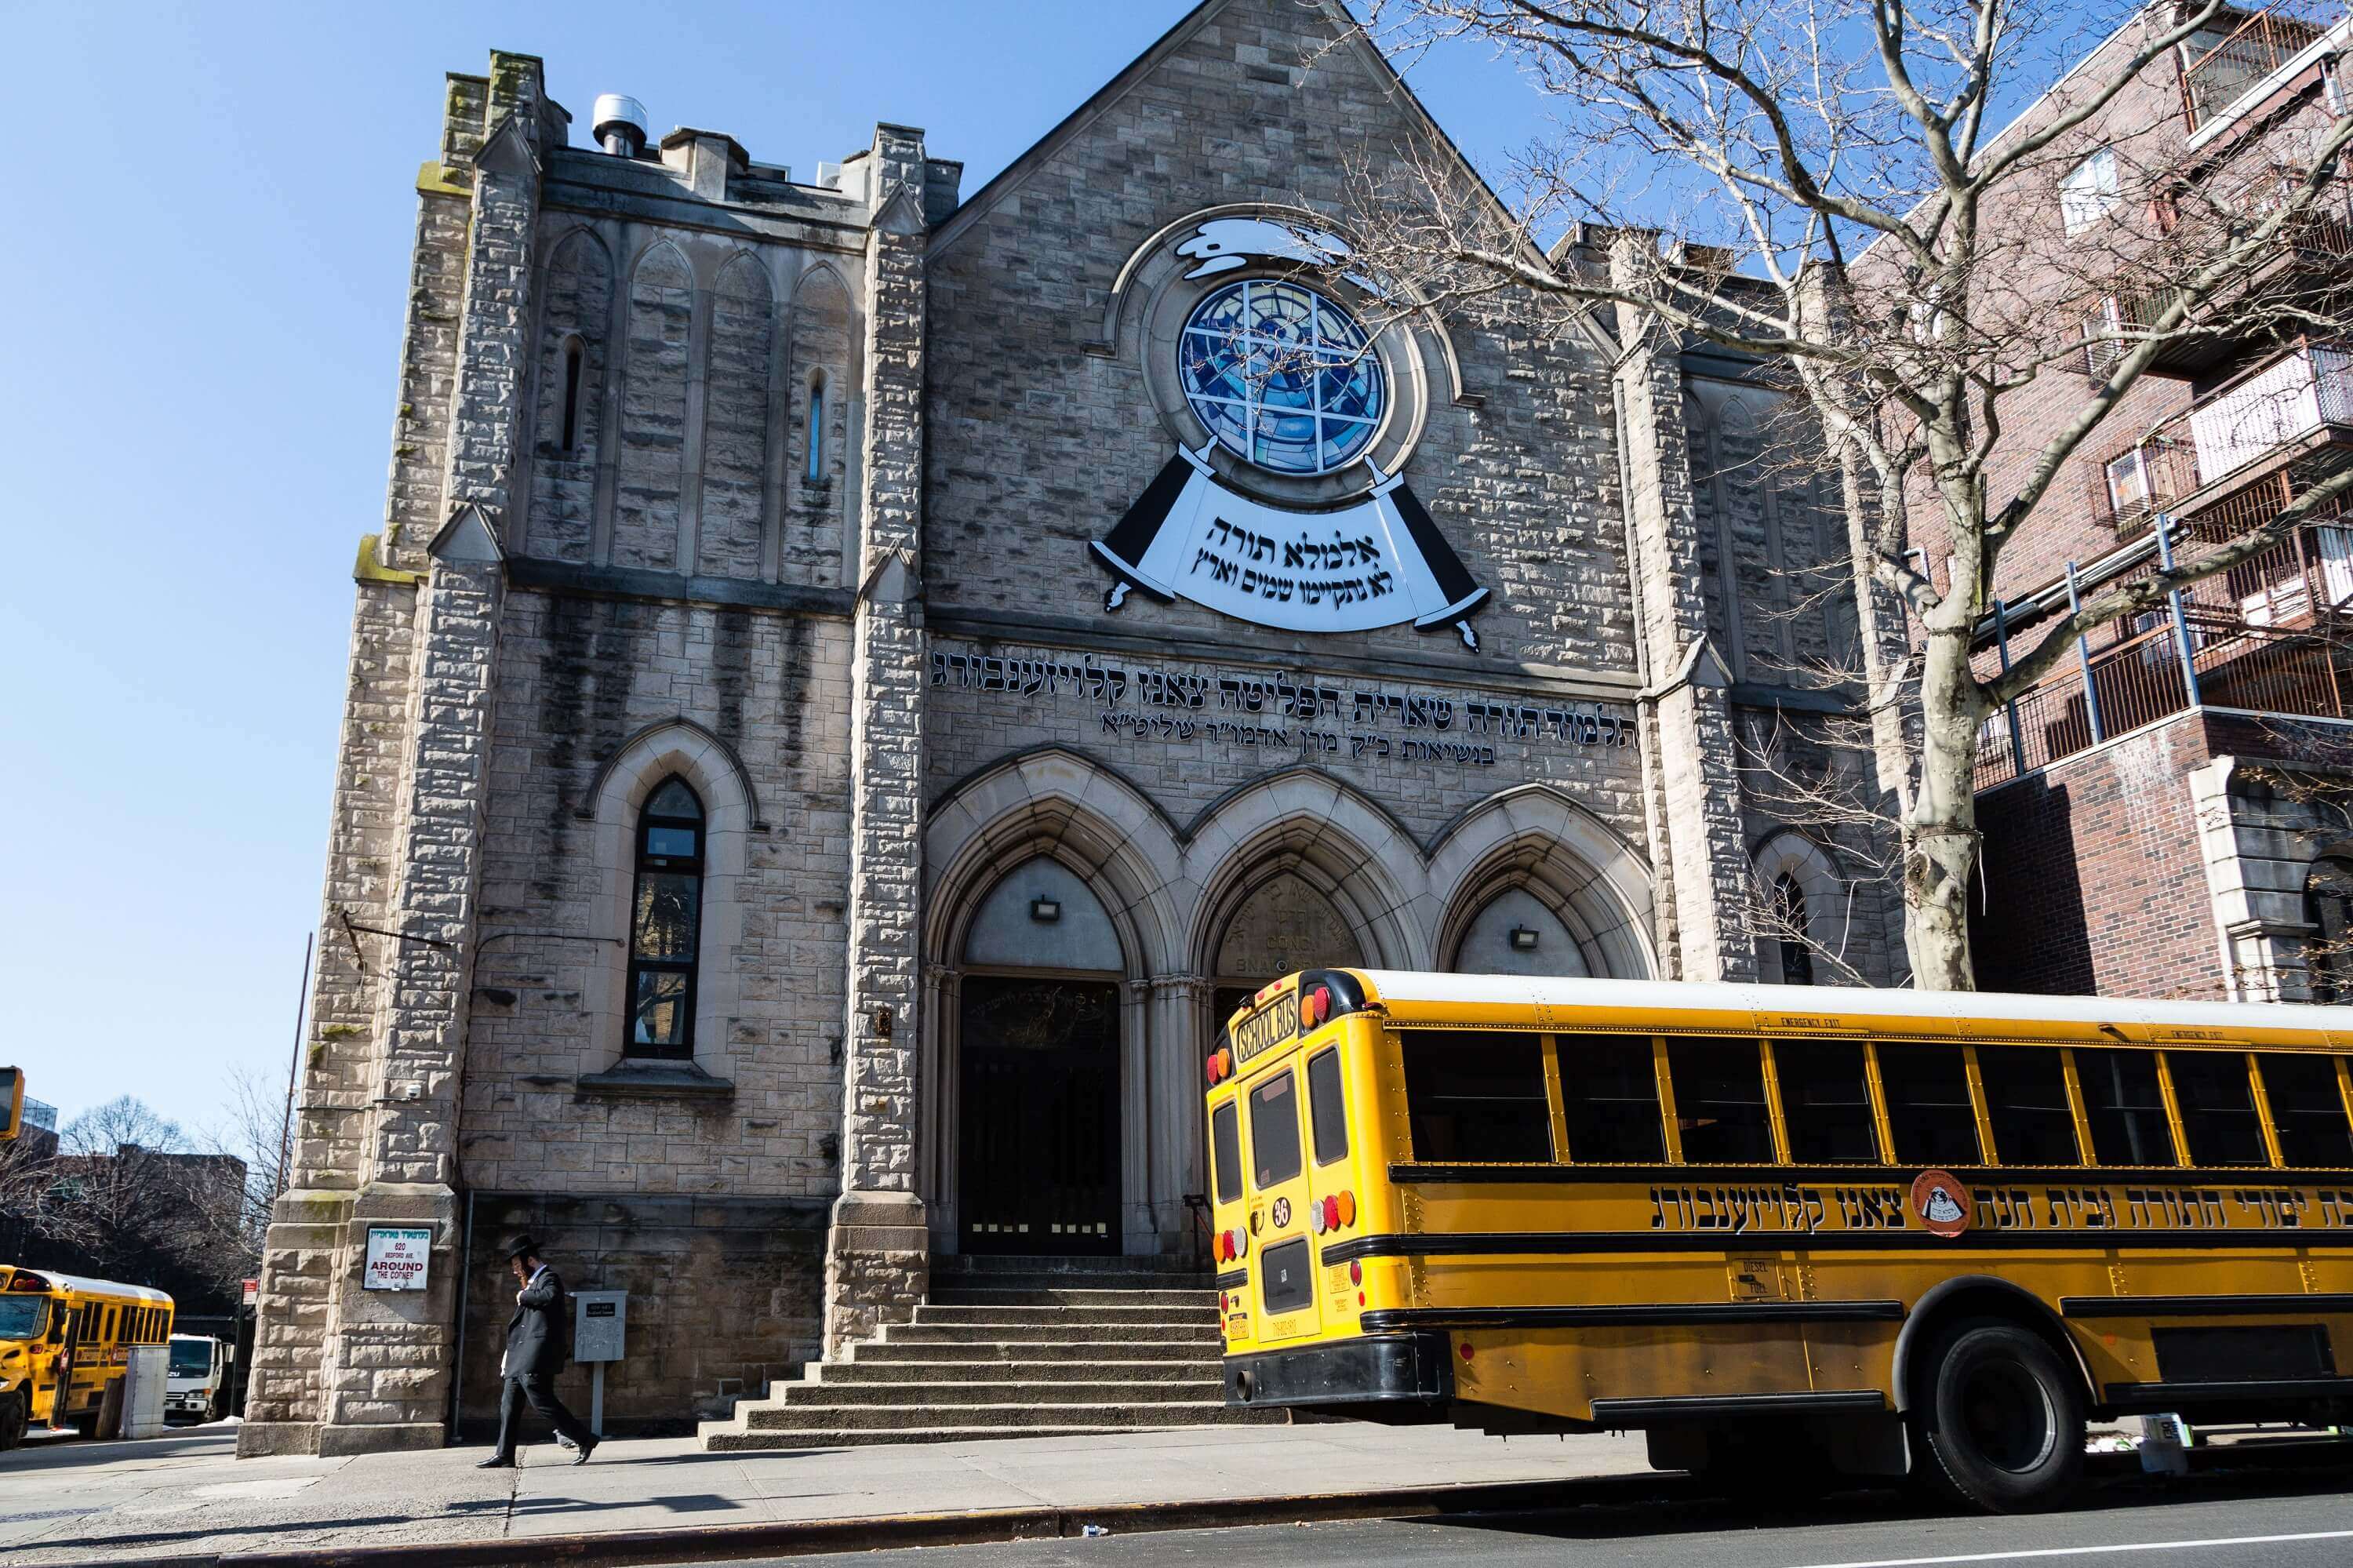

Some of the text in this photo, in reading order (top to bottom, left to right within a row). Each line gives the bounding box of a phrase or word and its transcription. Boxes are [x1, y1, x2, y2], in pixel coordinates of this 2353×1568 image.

[1206, 516, 1380, 570] אלמלא תורה
[1191, 547, 1394, 611] לא נתקיימו שמים וארץ
[931, 651, 1639, 748] תלמוד תורה שארית הפליטה צאנז קלויזענבורג
[1299, 728, 1339, 756] מרן
[1401, 737, 1496, 766] בנשיאות
[1240, 996, 1295, 1057] SCHOOL BUS
[1275, 1199, 1289, 1226] 36
[1649, 1180, 1825, 1235] קלויזענבורג
[1835, 1187, 1906, 1229] צאנז
[1973, 1187, 2036, 1229] חנה
[2046, 1187, 2118, 1229] ובית
[2126, 1187, 2228, 1229] התורה
[370, 1261, 424, 1271] AROUND
[1743, 1260, 1769, 1272] DIESEL
